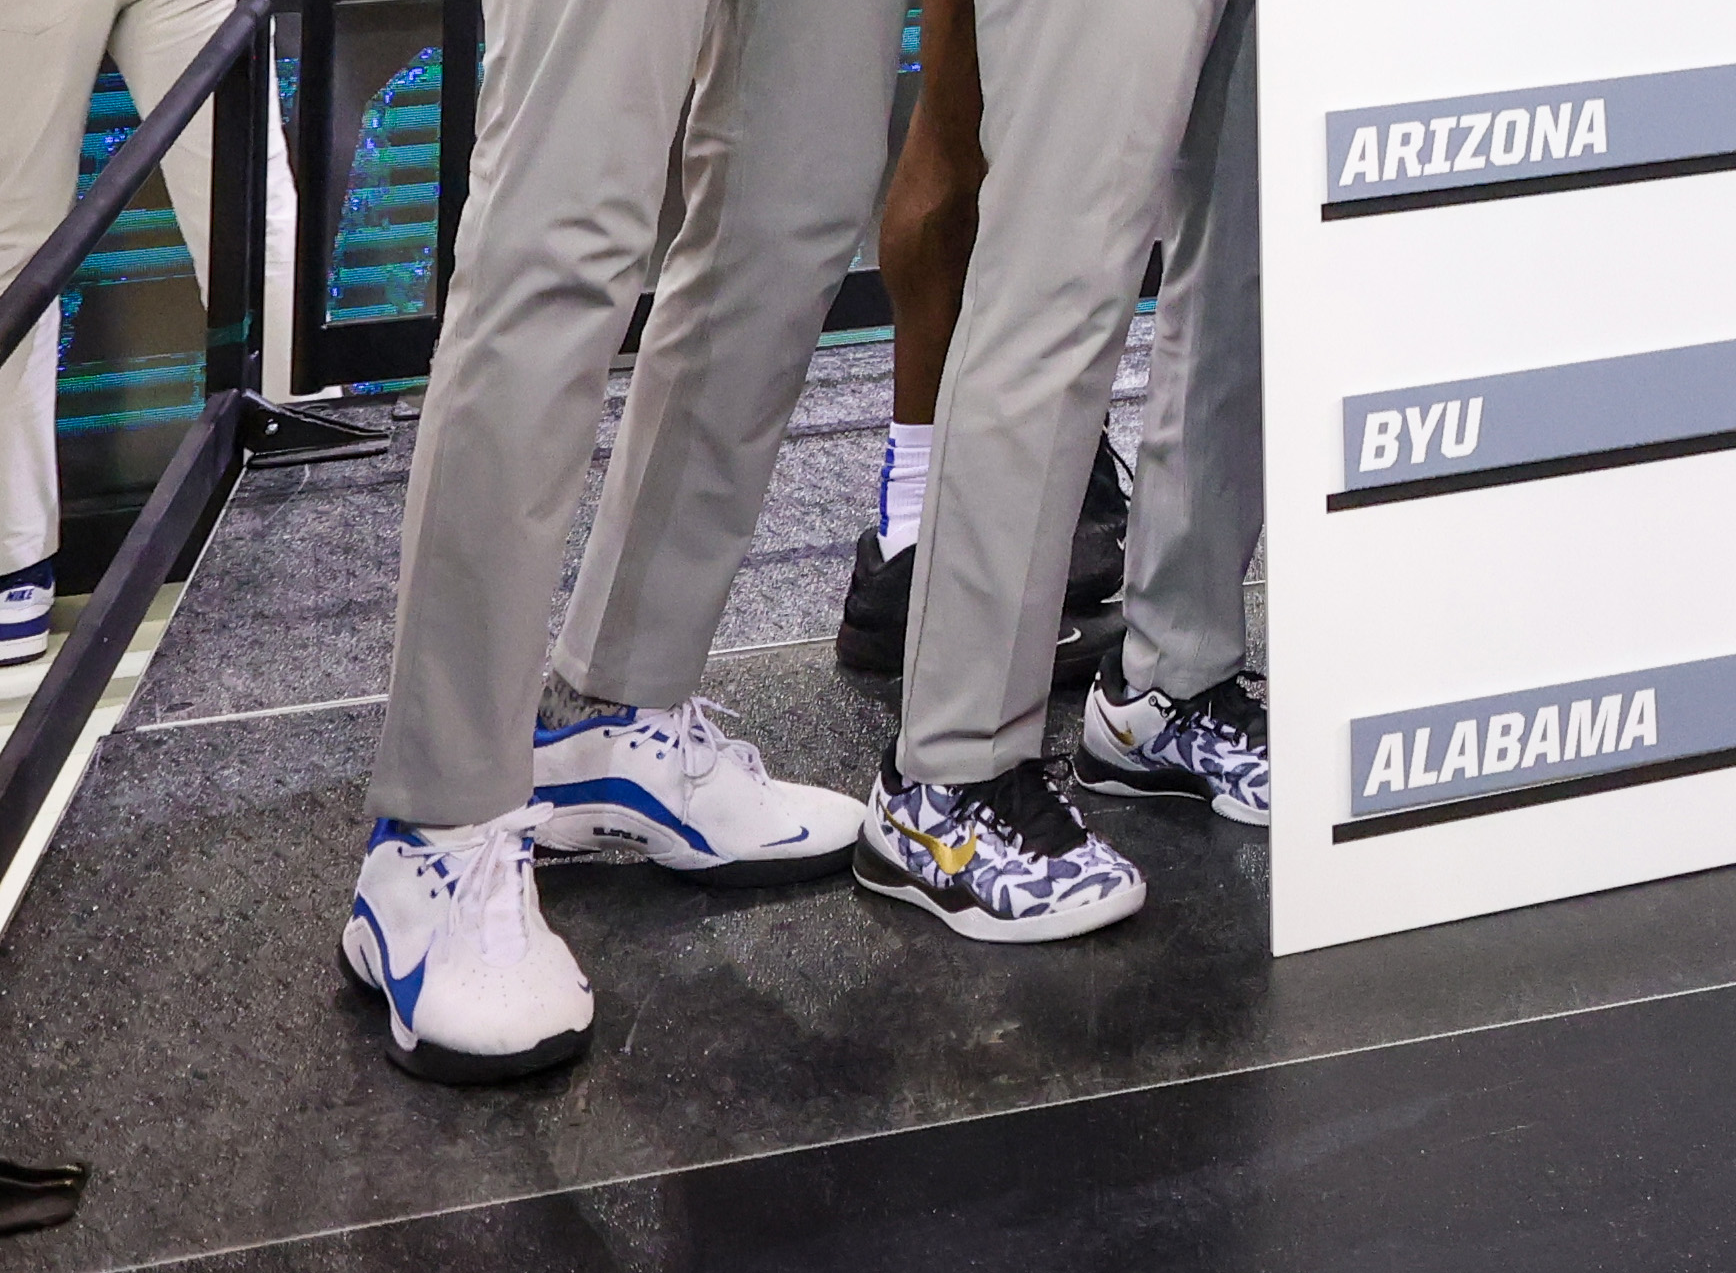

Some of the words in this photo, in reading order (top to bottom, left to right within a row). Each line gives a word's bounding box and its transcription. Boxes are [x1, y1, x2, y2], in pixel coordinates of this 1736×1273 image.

[1339, 99, 1607, 187] ARIZONA
[1358, 396, 1485, 473] BYU
[1363, 689, 1657, 798] ALABAMA
